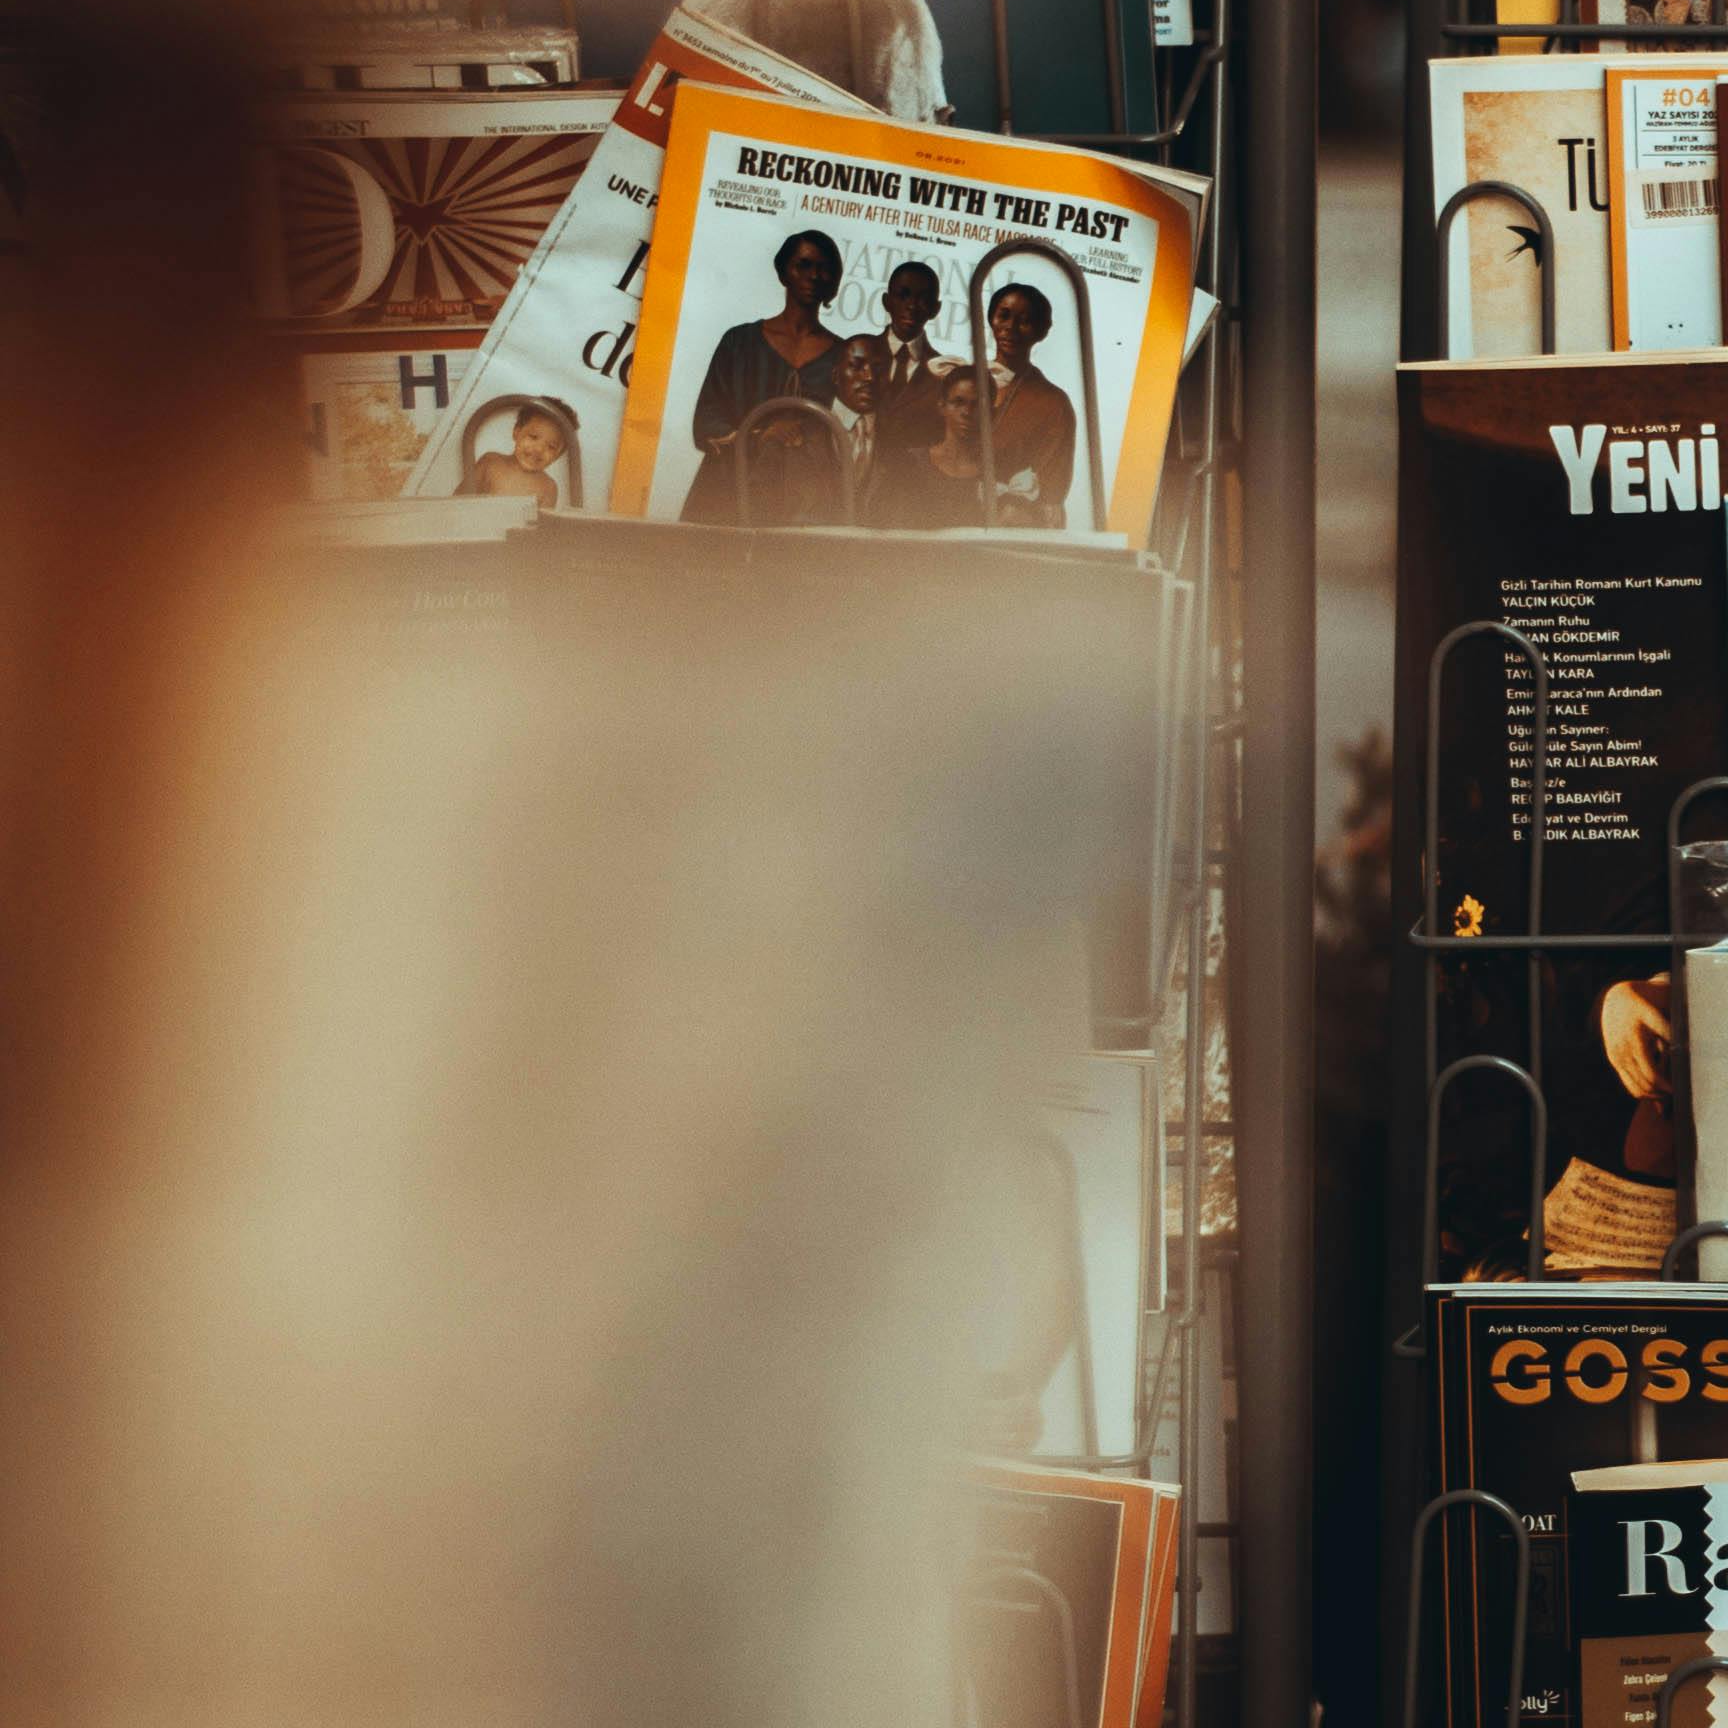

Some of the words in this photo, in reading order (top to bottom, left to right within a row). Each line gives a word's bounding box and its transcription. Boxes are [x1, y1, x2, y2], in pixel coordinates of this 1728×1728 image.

[1663, 88, 1710, 106] #04
[1649, 111, 1667, 120] YAZ
[500, 123, 557, 134] INTERNATIONAL
[560, 122, 587, 133] DESIGN
[606, 172, 649, 204] UNE
[737, 146, 902, 199] RECKONING
[909, 176, 988, 216] WITH
[992, 193, 1049, 229] THE
[1055, 202, 1130, 244] PAST
[801, 195, 812, 211] A
[812, 196, 863, 220] CENTURY
[865, 205, 901, 226] AFTER
[903, 210, 924, 230] THE
[926, 214, 960, 237] TULSA
[963, 221, 993, 242] RACE
[1549, 423, 1720, 515] YENİ
[1501, 579, 1527, 591] Gizli
[1531, 579, 1572, 590] Tarihin
[1575, 578, 1622, 590] Romanı
[1625, 577, 1652, 589] Kurt
[1656, 576, 1703, 588] Kanunu
[1502, 597, 1548, 610] YALÇIN
[1550, 595, 1596, 609] KÜÇÜK
[1503, 616, 1555, 628] Zamanın
[1558, 615, 1590, 627] Ruhu
[1552, 629, 1620, 644] GÖKDEMİR
[1553, 650, 1636, 663] Konumlarının
[1558, 668, 1595, 679] KARA
[1608, 686, 1662, 698] Ardından
[1555, 704, 1590, 715] KALE
[1570, 740, 1603, 753] Sayın
[1607, 739, 1642, 751] Abim!
[1590, 756, 1659, 768] ALBAYRAK
[1584, 812, 1629, 823] Devrim
[1572, 828, 1641, 841] ALBAYRAK
[1518, 1323, 1563, 1334] Ekonomi
[1582, 1323, 1629, 1335] Cemiyet
[1631, 1323, 1667, 1336] Dergisi
